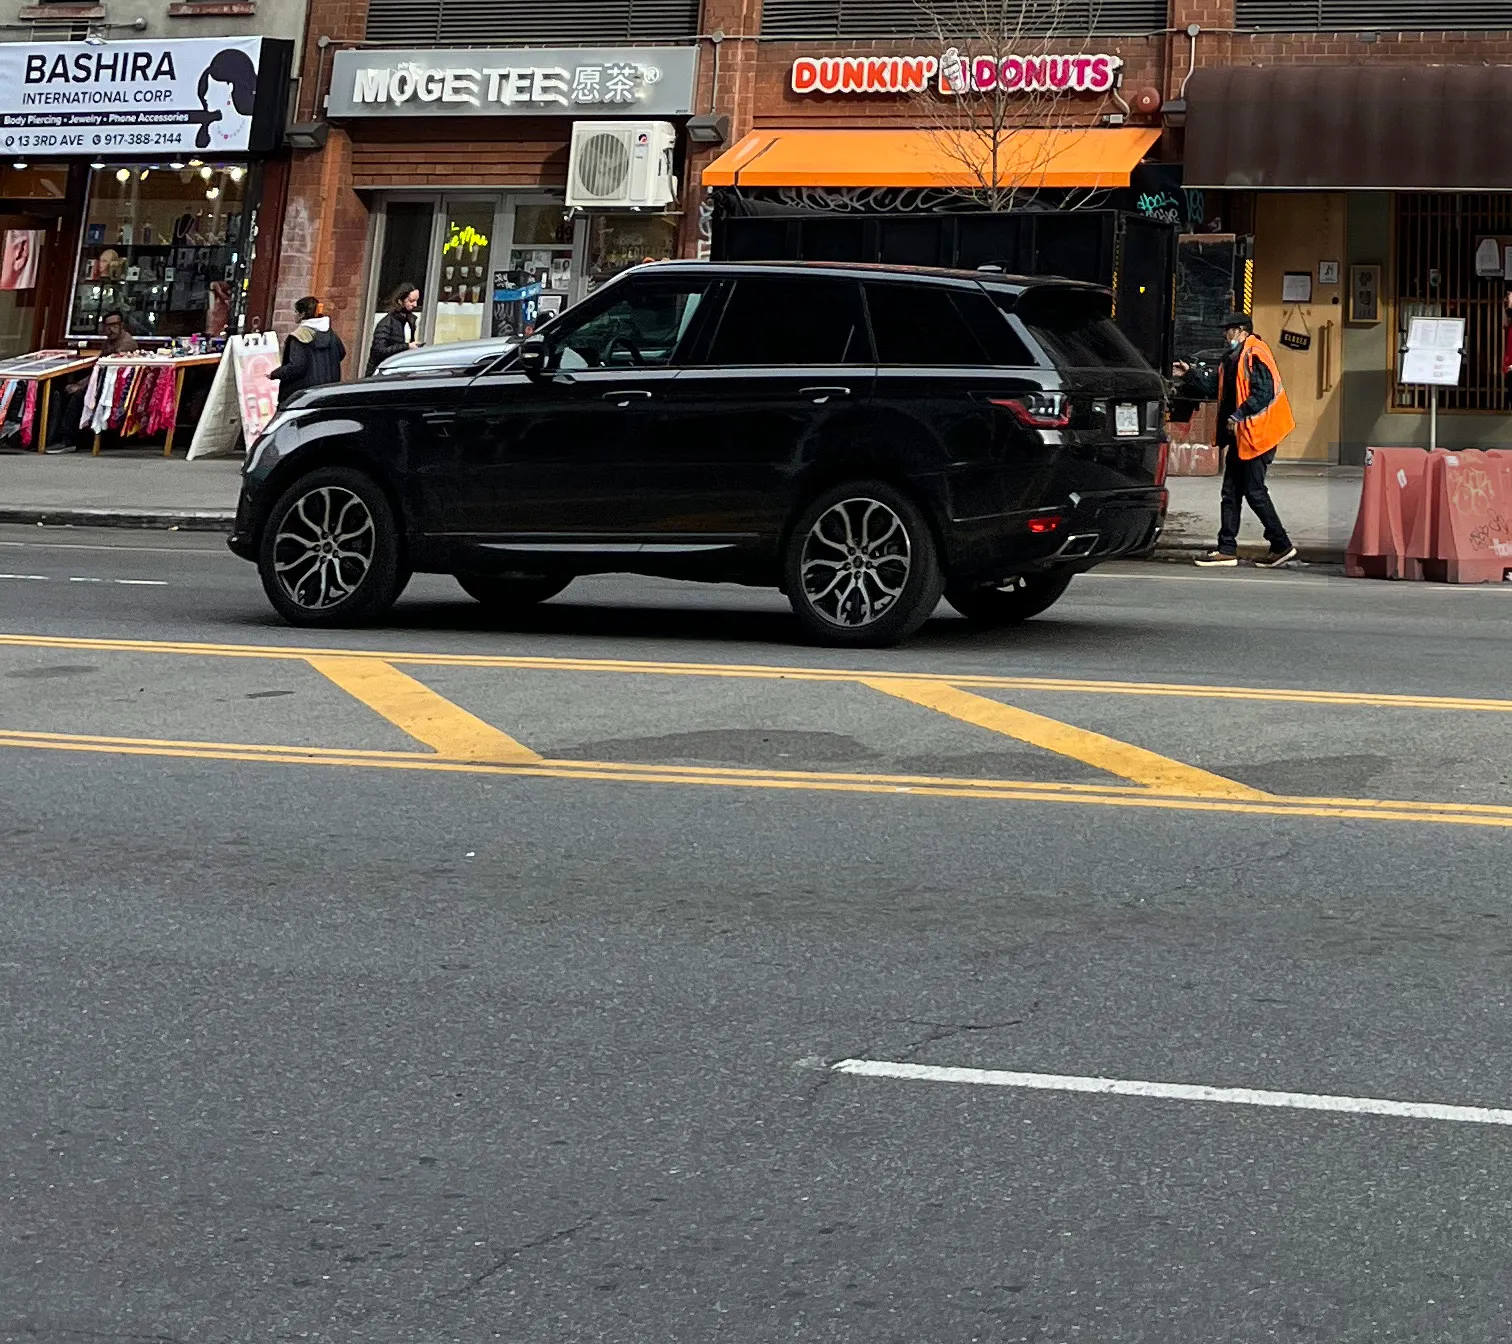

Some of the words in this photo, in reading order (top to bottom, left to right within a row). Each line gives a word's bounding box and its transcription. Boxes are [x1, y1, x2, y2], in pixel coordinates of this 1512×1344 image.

[25, 52, 176, 84] BASHIRA
[795, 61, 934, 89] DUNKIN'
[975, 58, 1111, 88] DONUTS
[22, 90, 129, 105] INTERNATIONAL
[134, 89, 174, 103] CORP.
[482, 67, 568, 106] TEE
[3, 115, 26, 127] Body
[27, 115, 62, 126] Piercing
[69, 114, 102, 125] Jewelry
[108, 114, 136, 123] Phone
[138, 112, 189, 123] Accessories
[18, 135, 30, 147] 13
[32, 135, 57, 146] 3RD
[60, 134, 84, 146] AVE
[104, 132, 182, 146] 917-388-2144
